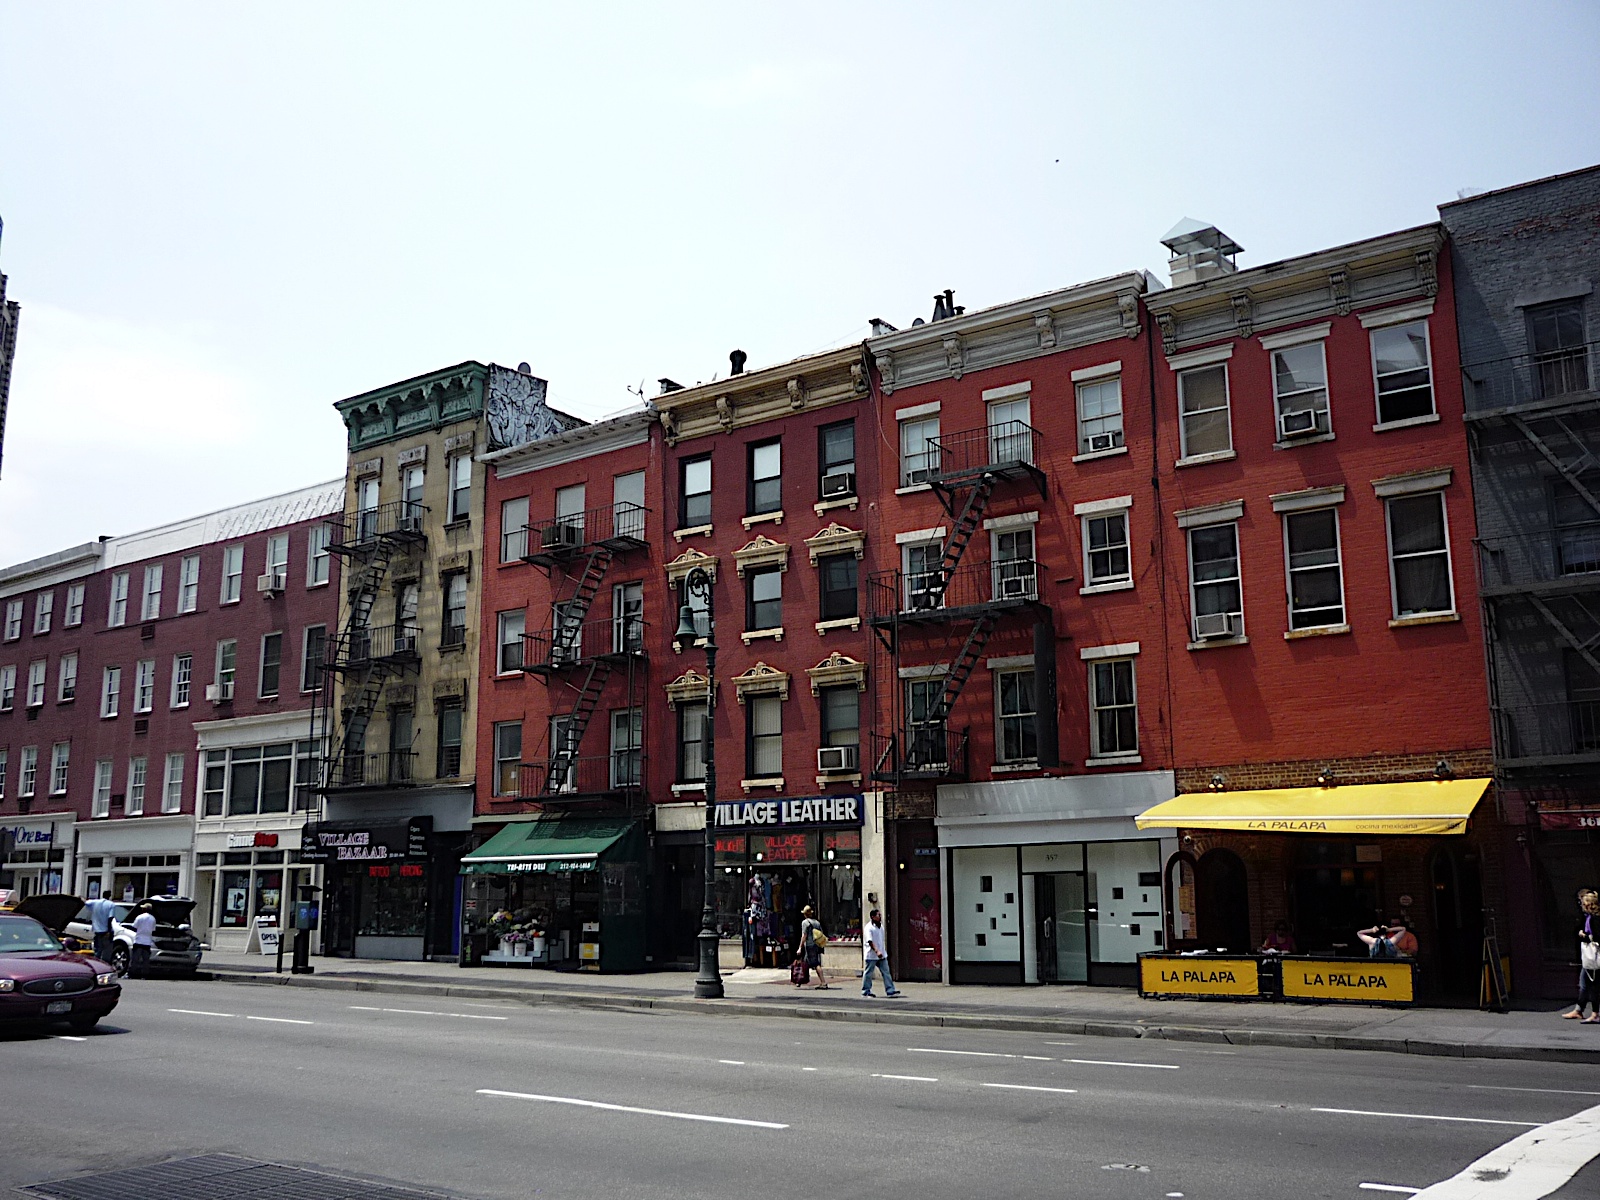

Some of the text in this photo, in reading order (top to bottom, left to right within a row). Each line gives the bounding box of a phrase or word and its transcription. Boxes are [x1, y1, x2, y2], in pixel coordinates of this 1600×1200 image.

[714, 797, 858, 827] VILLAGE LEATHER
[1247, 820, 1327, 831] LA PALAPA
[1355, 821, 1418, 830] cocina mexicana
[17, 826, 35, 844] One
[35, 831, 52, 842] Ban
[318, 832, 370, 847] VILLAGE
[763, 835, 807, 848] VILLAGE
[825, 835, 860, 849] SHOES
[337, 846, 388, 860] BAZAAR
[762, 848, 807, 862] LEATHER
[532, 862, 547, 871] DELI
[261, 933, 277, 941] OPEN
[1161, 970, 1236, 984] LA PALAPA
[1303, 973, 1388, 988] LA PALAPA
